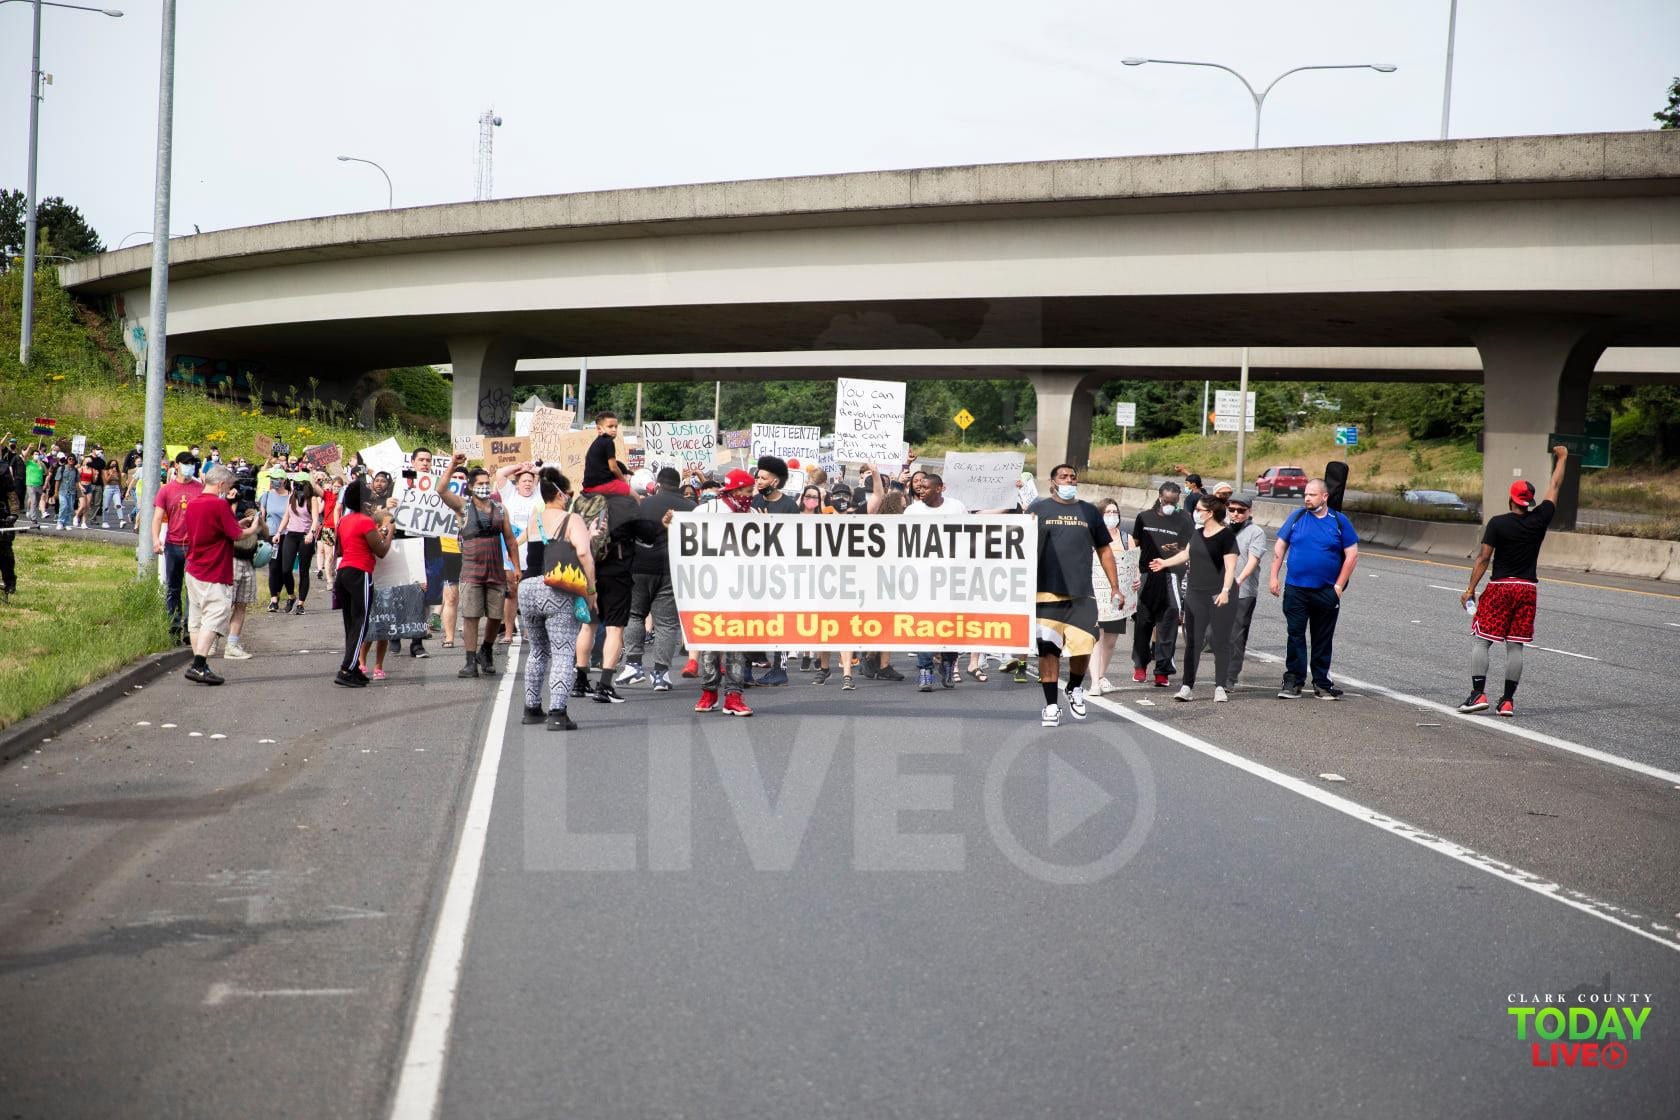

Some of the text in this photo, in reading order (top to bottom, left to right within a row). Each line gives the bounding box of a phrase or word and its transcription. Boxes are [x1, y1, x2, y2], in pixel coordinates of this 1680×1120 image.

[840, 380, 895, 399] You can
[644, 422, 712, 436] NO Justice
[854, 418, 881, 431] BUT
[754, 425, 820, 440] JUNETEENTH
[837, 431, 858, 441] you
[646, 437, 701, 450] NO Peace
[869, 441, 887, 449] the
[953, 462, 985, 472] BLACK
[968, 475, 1005, 484] MATTER
[402, 488, 416, 503] IS
[394, 505, 459, 535] CRIME
[680, 522, 1026, 560] BLACK LIVES MATTER
[676, 563, 1028, 608] NO JUSTICE, NO PEACE
[692, 613, 1012, 642] Stand Up to Racism
